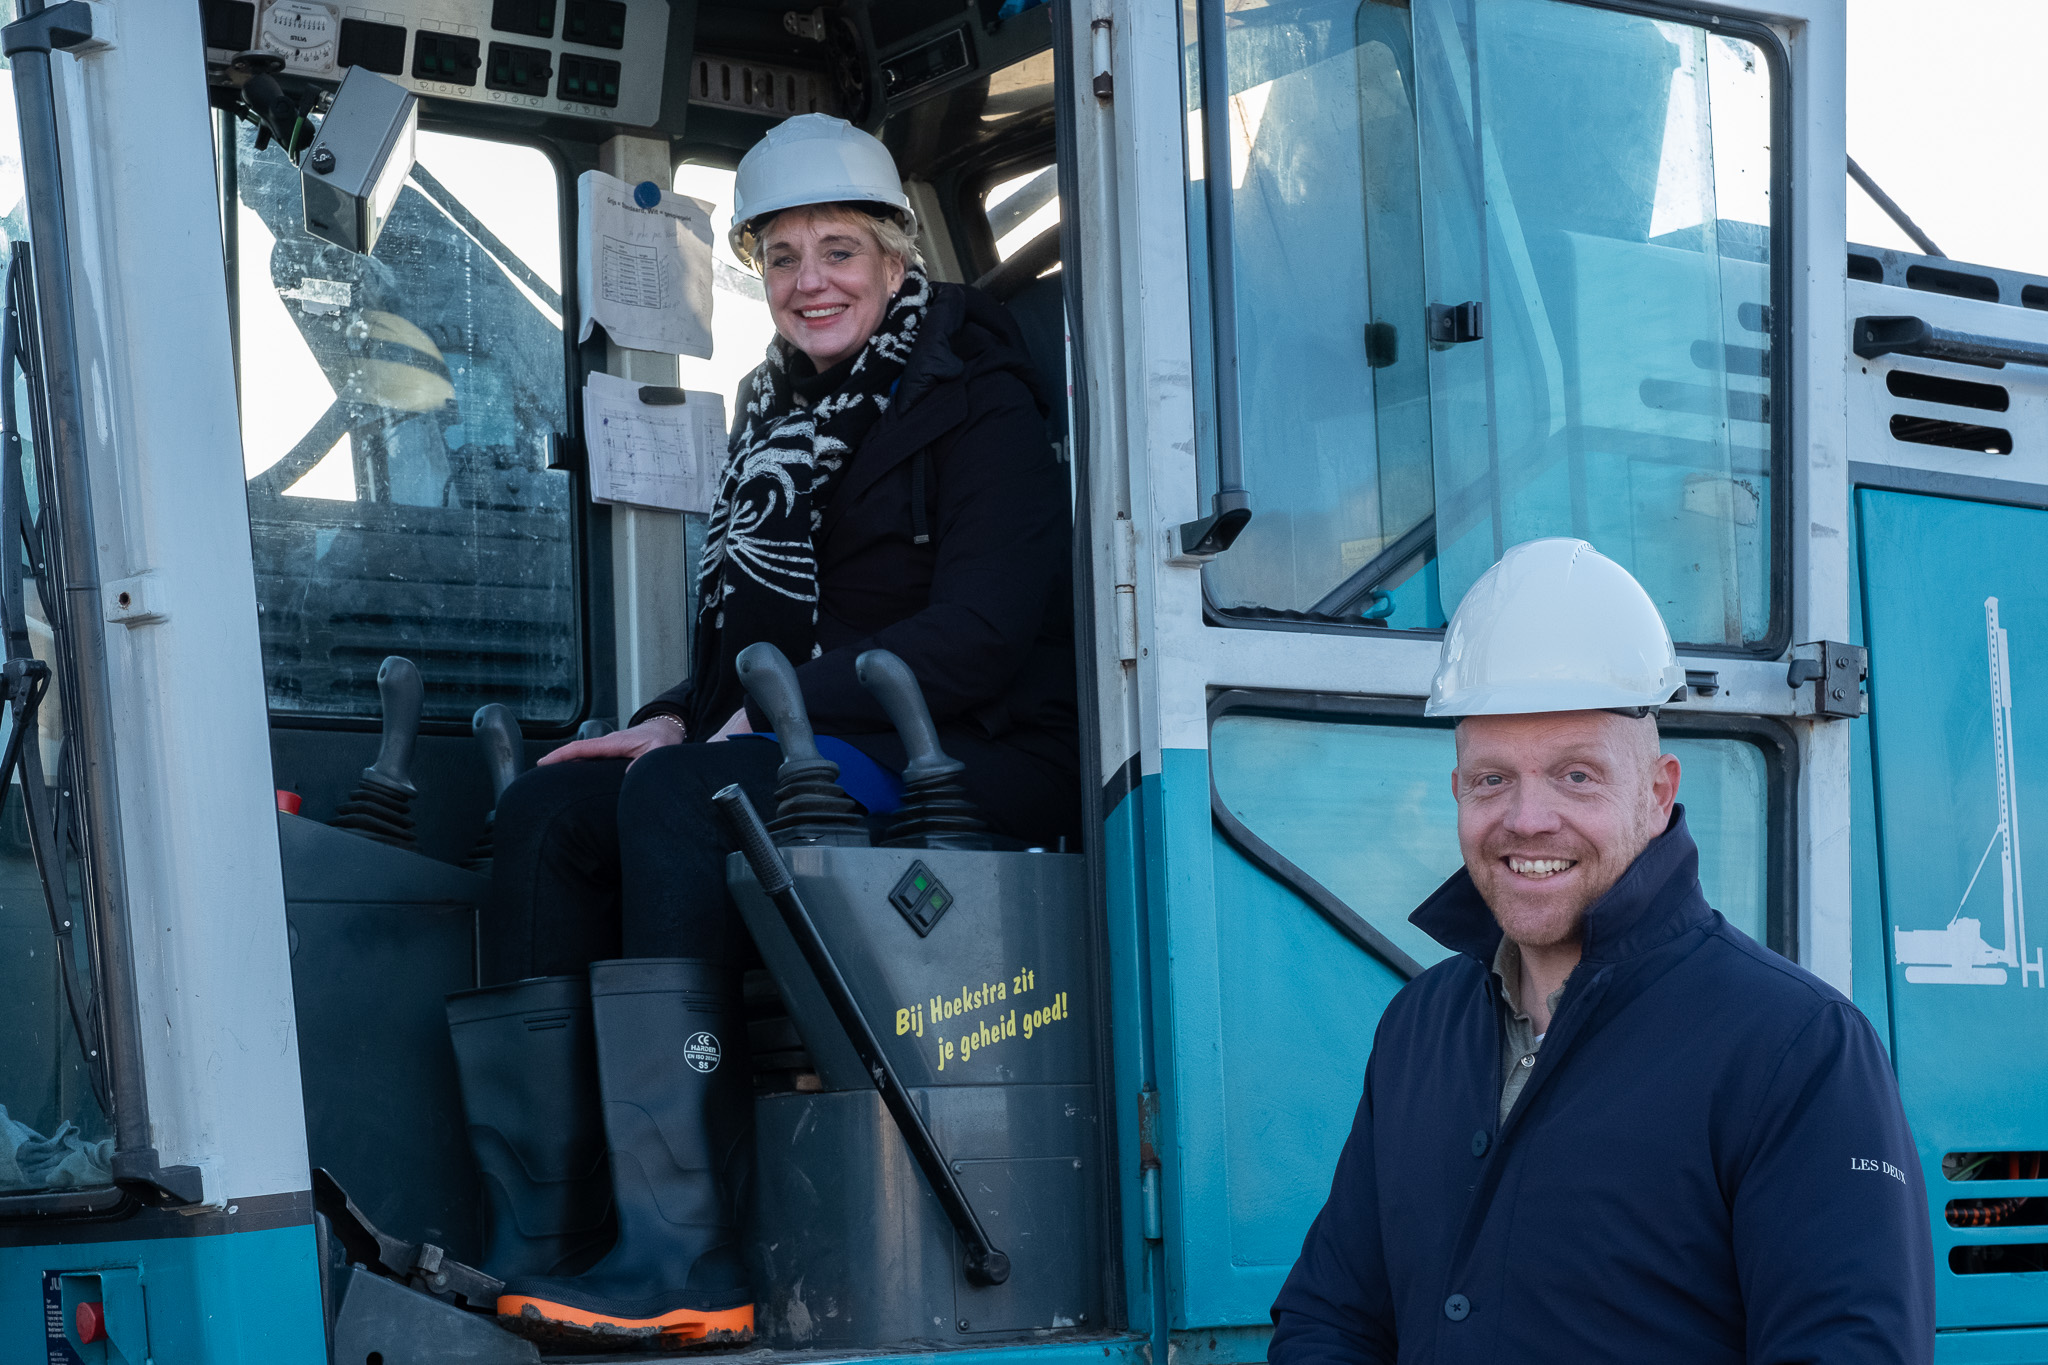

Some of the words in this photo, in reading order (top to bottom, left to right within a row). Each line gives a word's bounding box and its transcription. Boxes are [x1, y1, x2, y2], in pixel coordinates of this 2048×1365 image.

[896, 1003, 923, 1038] Bij
[930, 982, 1006, 1024] Hoekstra
[1013, 966, 1035, 995] zit
[698, 1035, 709, 1045] CE
[937, 1036, 954, 1071] je
[960, 1009, 1016, 1062] geheid
[1023, 991, 1068, 1040] goed!
[698, 1061, 709, 1069] S5
[1851, 1157, 1879, 1171] LES
[1882, 1161, 1906, 1184] DEUX
